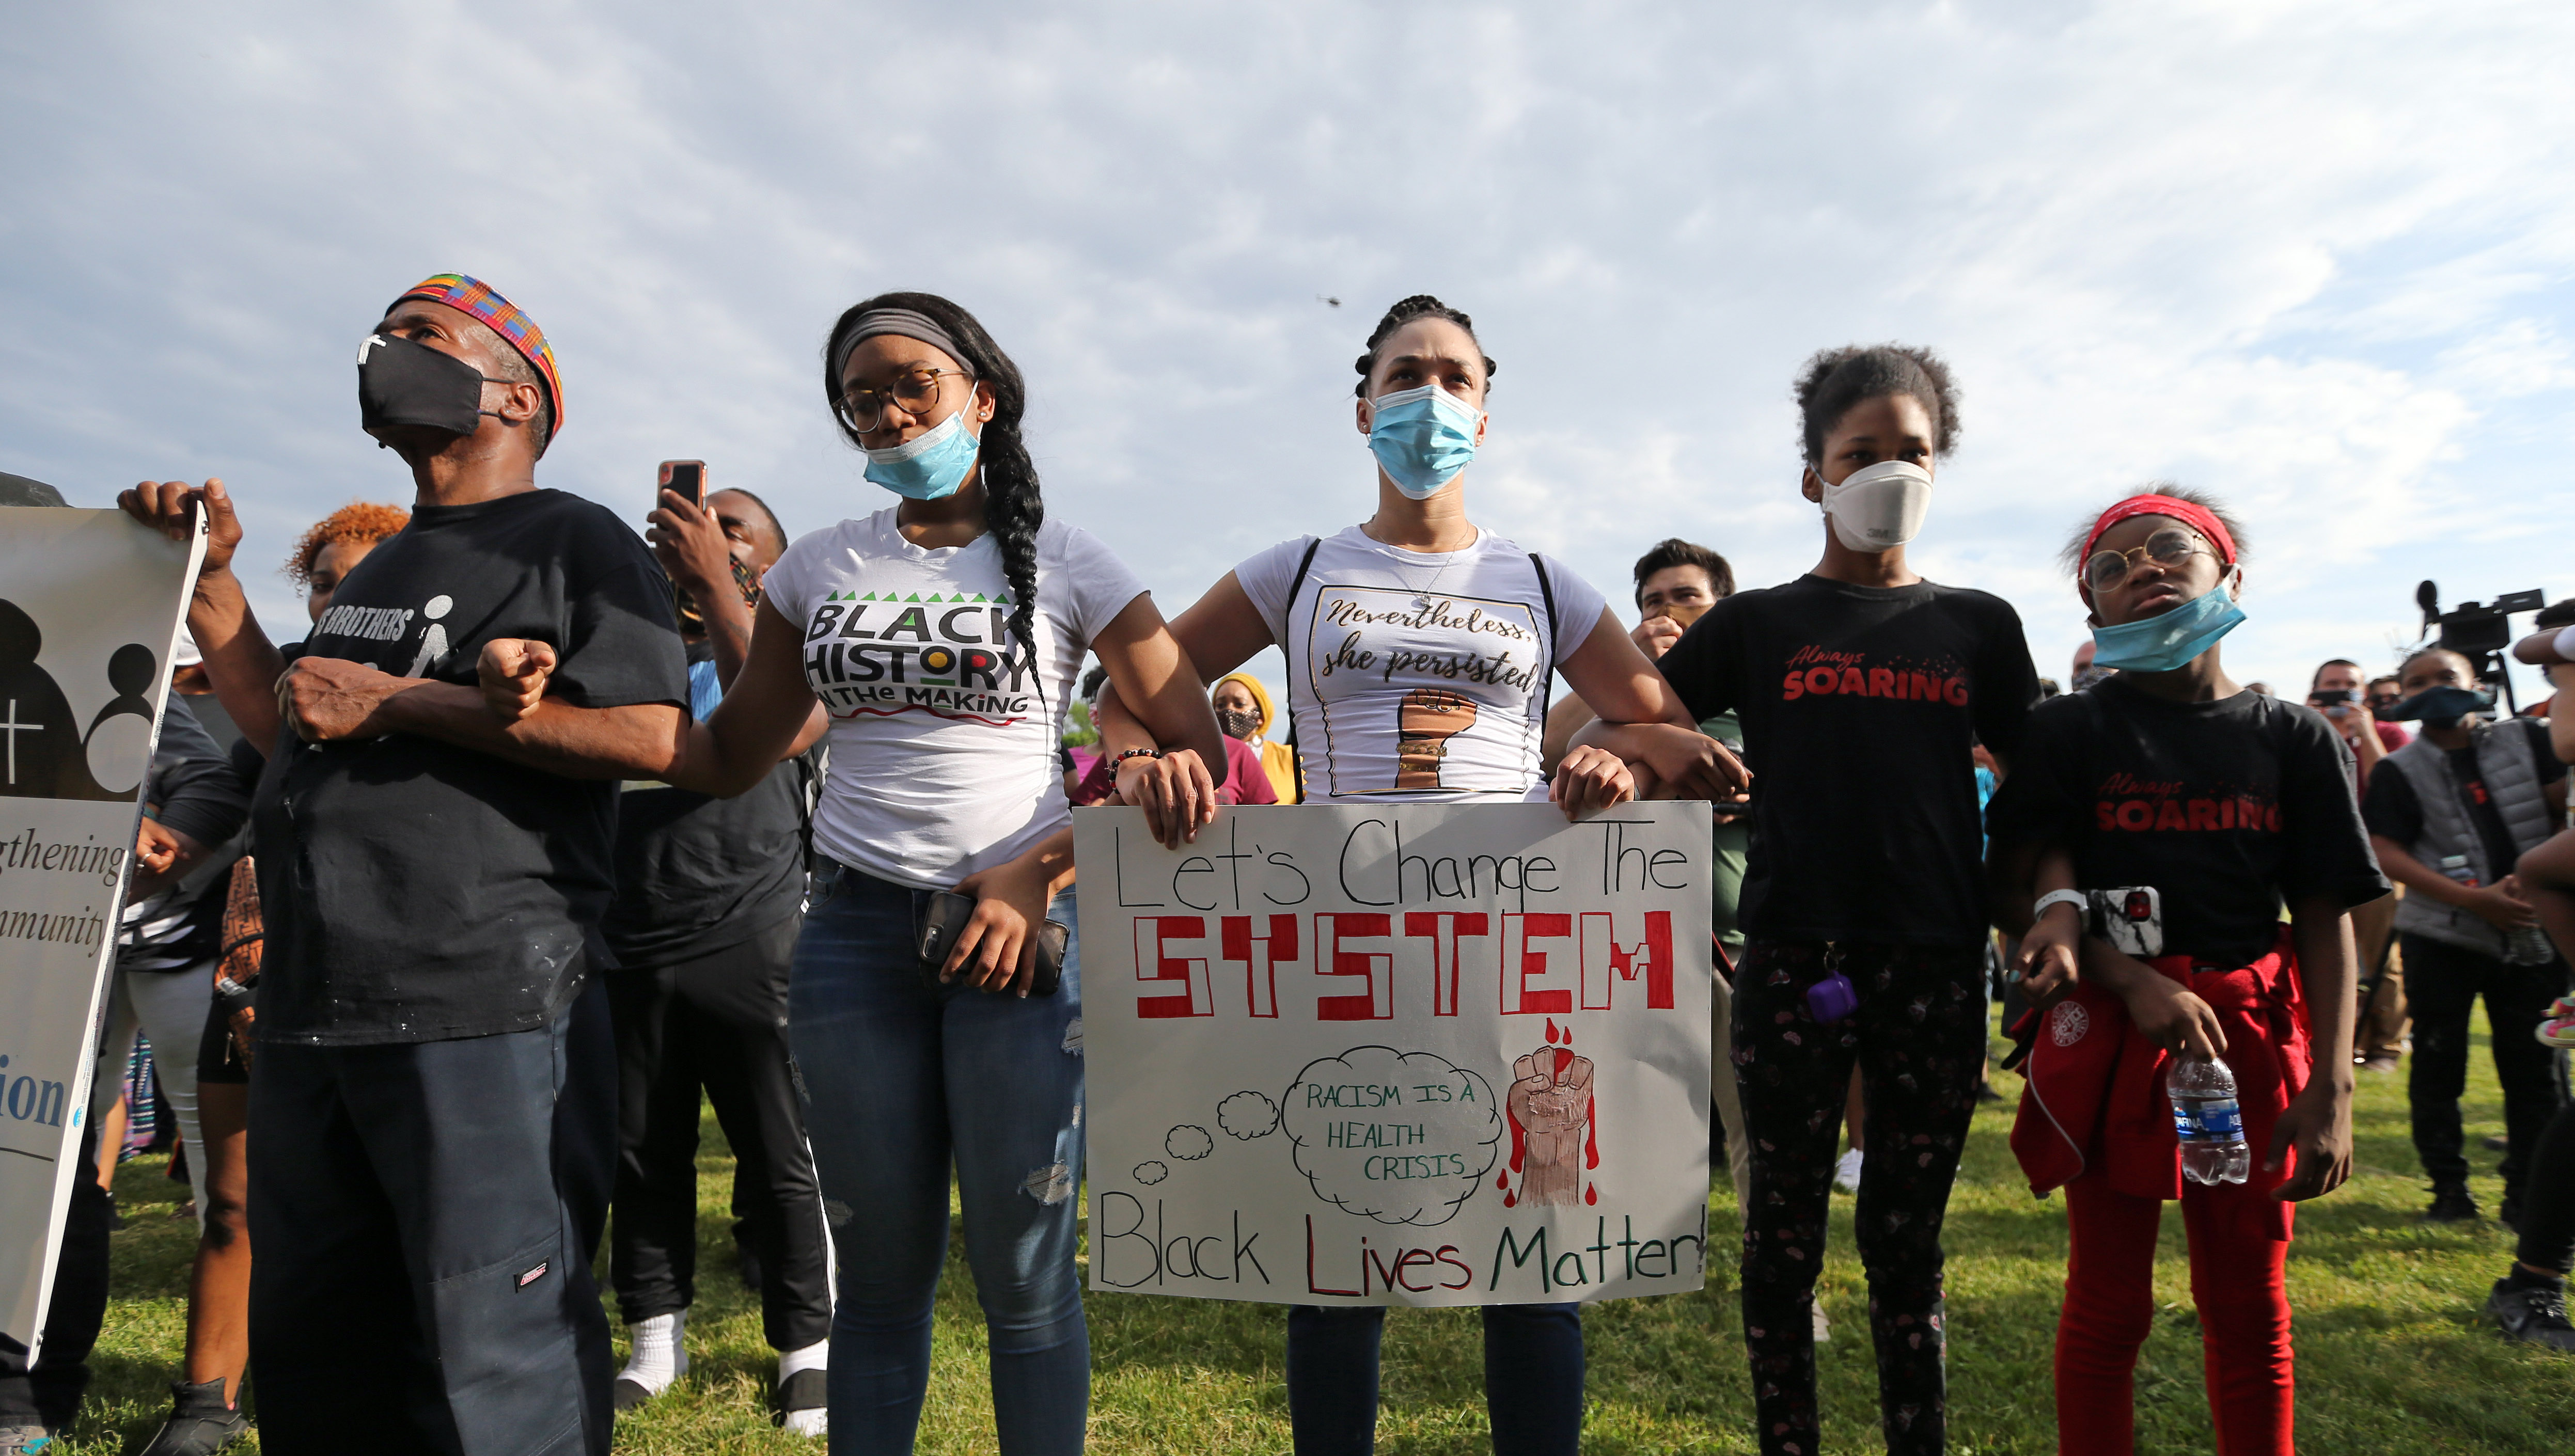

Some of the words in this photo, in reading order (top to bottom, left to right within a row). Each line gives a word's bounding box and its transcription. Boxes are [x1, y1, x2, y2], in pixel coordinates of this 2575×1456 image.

[1867, 528, 1889, 539] 3M
[323, 605, 415, 642] BROTHERS
[806, 604, 1015, 645] BLACK
[1325, 599, 1532, 642] Nevertheless,
[804, 642, 1030, 692] HISTORY
[1322, 630, 1377, 677] she
[1384, 651, 1539, 693] persisted
[1785, 645, 1866, 671] Always
[1783, 666, 1968, 707] SOARING
[2098, 772, 2184, 806] Always
[1115, 816, 1311, 911] Let's
[1339, 819, 1560, 913] Change
[1570, 820, 1688, 896] The
[1134, 910, 1674, 1021] SYSTEM
[1307, 1083, 1401, 1109] RACISM
[1412, 1084, 1452, 1102] IS
[1459, 1083, 1475, 1102] A
[1327, 1121, 1425, 1149] HEALTH
[1364, 1153, 1465, 1181] CRISIS
[1101, 1191, 1270, 1288] Black
[1306, 1213, 1473, 1297] Lives
